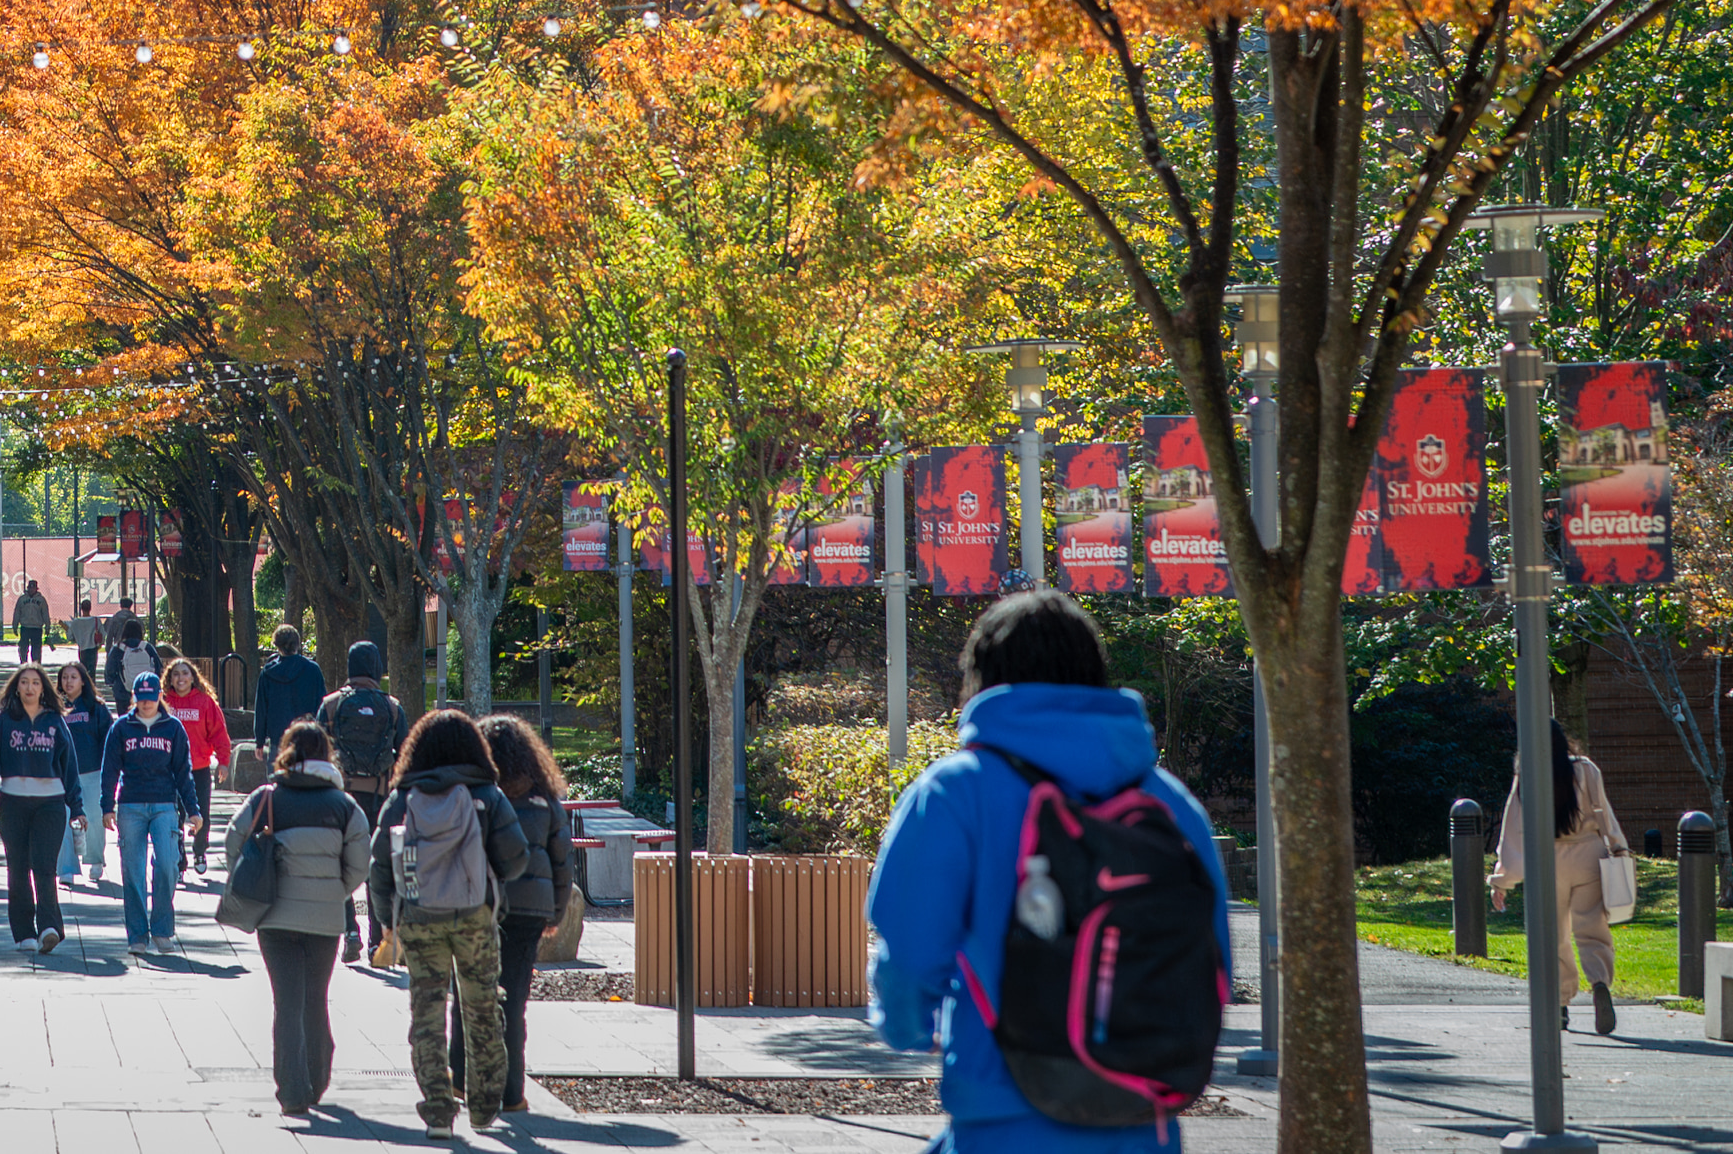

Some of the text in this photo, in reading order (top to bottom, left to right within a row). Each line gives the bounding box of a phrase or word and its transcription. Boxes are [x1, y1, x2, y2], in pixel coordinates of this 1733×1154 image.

[1387, 480, 1479, 503] ST. JOHN'S
[1388, 502, 1478, 515] UNIVERSITY
[1568, 503, 1666, 536] elevates
[938, 521, 1000, 536] ST. JOHN'S
[566, 537, 607, 552] elevates
[813, 537, 871, 558] elevates
[938, 536, 999, 545] UNIVERSITY
[1062, 537, 1128, 559] elevates
[139, 737, 172, 753] JOHN'S
